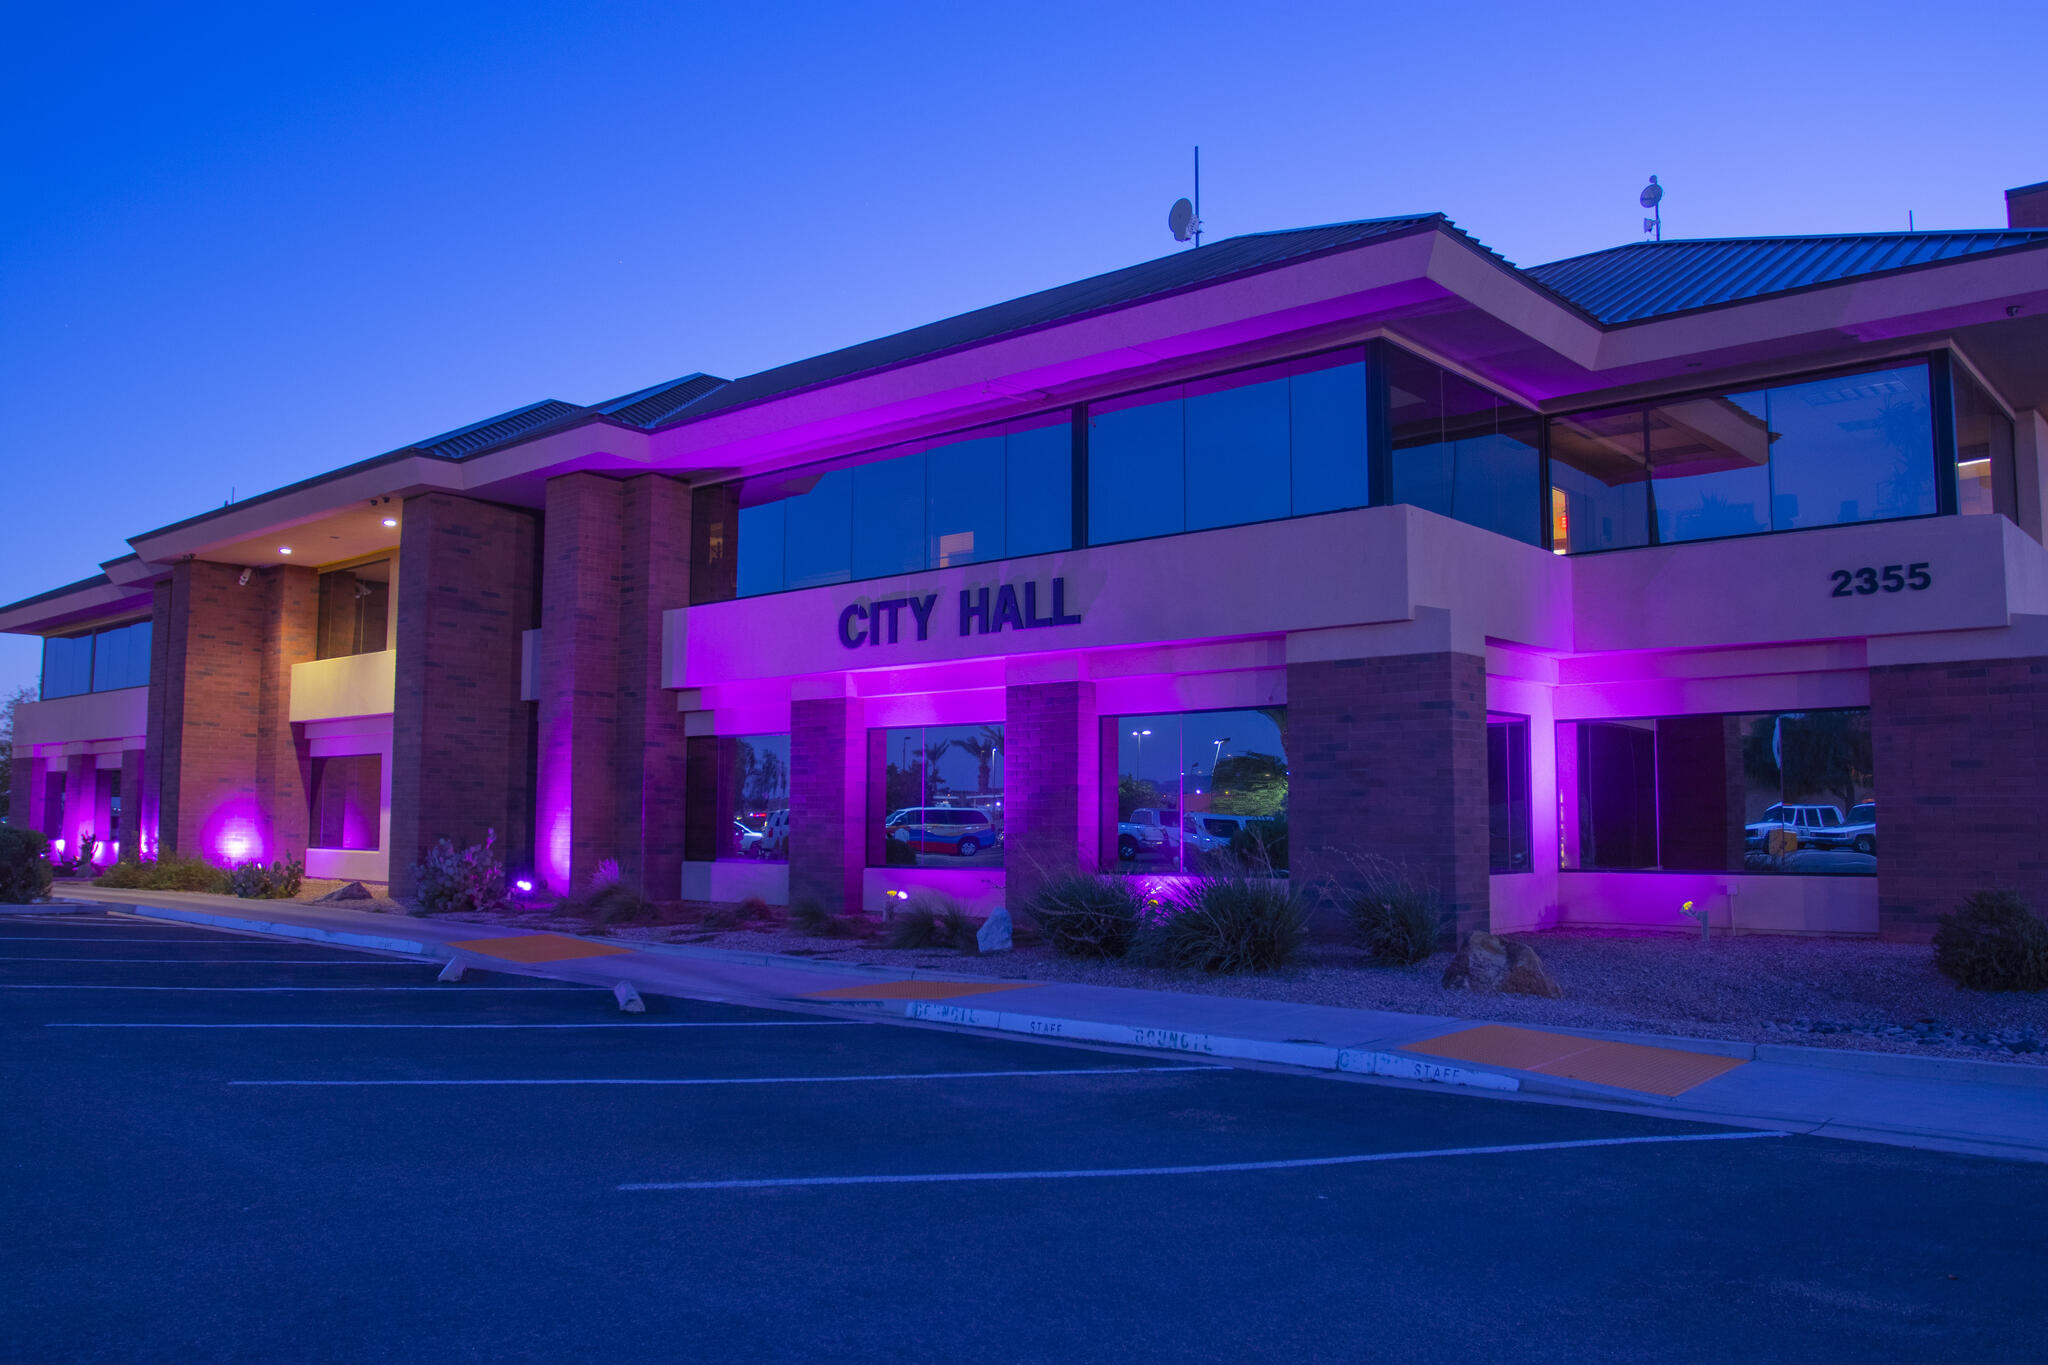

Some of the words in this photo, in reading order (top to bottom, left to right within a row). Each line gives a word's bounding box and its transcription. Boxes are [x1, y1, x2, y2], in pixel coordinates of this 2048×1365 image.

[1830, 562, 1932, 598] 2355
[838, 593, 938, 649] CITY
[959, 577, 1081, 637] HALL
[1030, 1021, 1063, 1033] STAFF
[1413, 1063, 1460, 1081] STAFF
